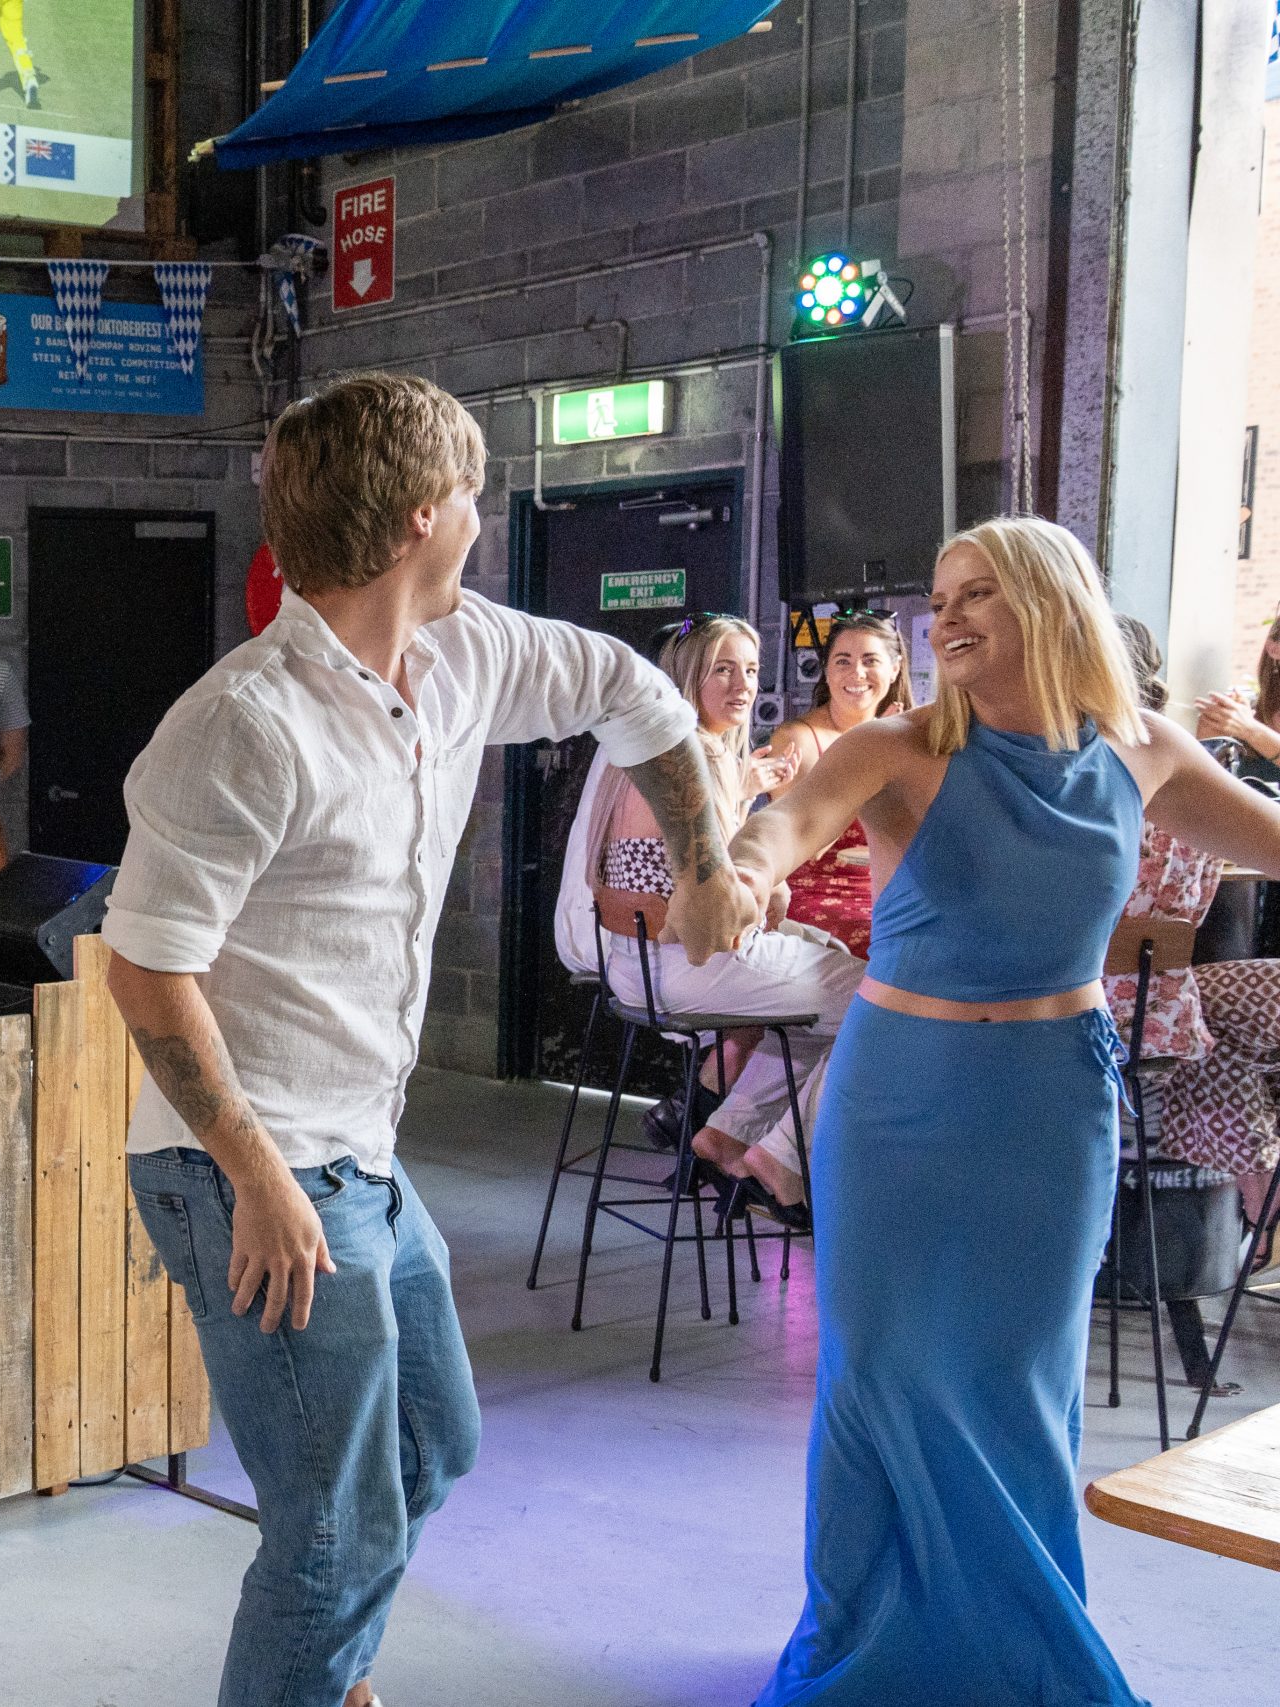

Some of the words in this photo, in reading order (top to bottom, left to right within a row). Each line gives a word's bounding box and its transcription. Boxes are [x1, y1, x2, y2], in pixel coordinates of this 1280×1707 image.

[341, 188, 387, 221] FIRE
[340, 225, 387, 253] HOSE
[31, 313, 53, 331] OUR
[97, 318, 162, 339] OKTOBERFEST
[46, 337, 69, 349] BAND
[32, 352, 61, 364] STEIN
[88, 356, 116, 367] ETZEL
[607, 573, 680, 588] EMERGENCY
[630, 586, 656, 598] EXIT
[1124, 1169, 1138, 1190] 4
